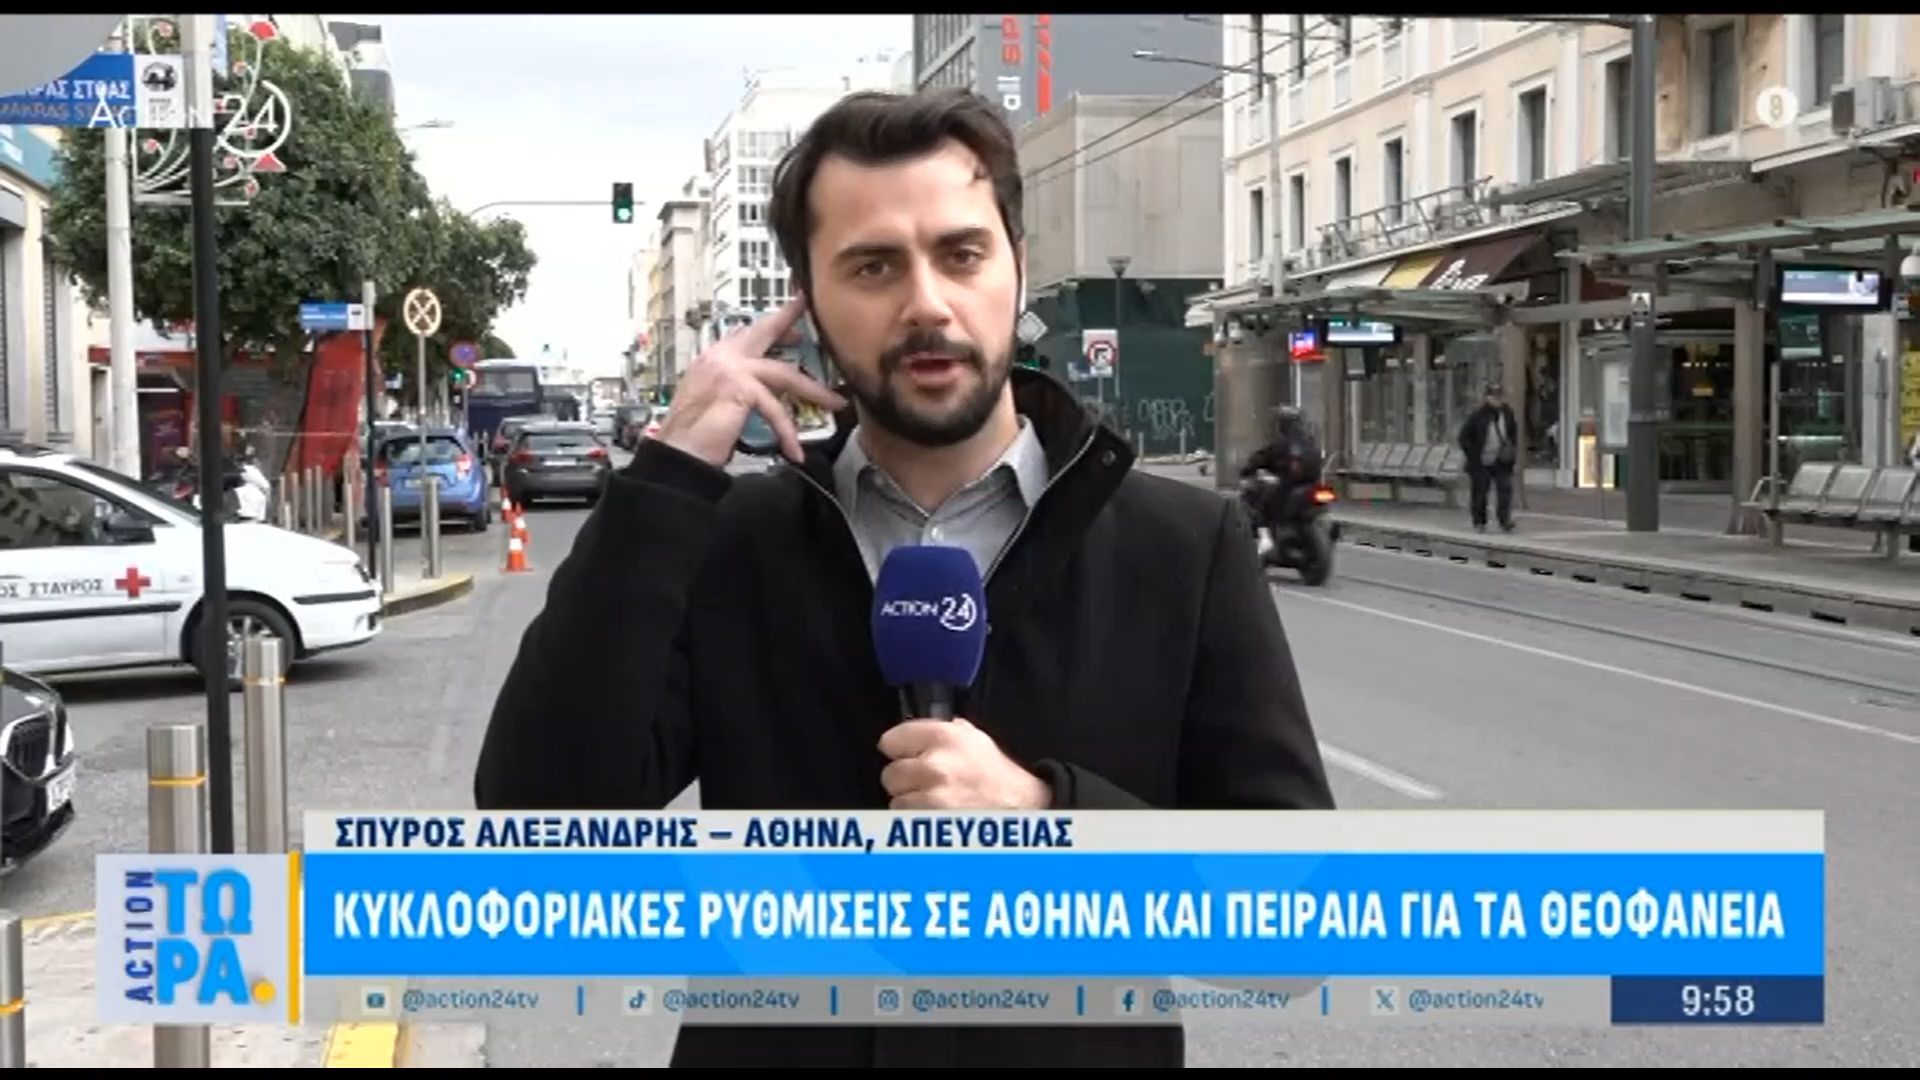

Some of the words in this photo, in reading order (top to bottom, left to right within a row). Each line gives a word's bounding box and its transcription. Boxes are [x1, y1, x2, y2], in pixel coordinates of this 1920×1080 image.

[29, 579, 103, 595] ΣΤΑΥΡΟΣ
[880, 601, 938, 617] ACTION
[941, 595, 974, 626] 24
